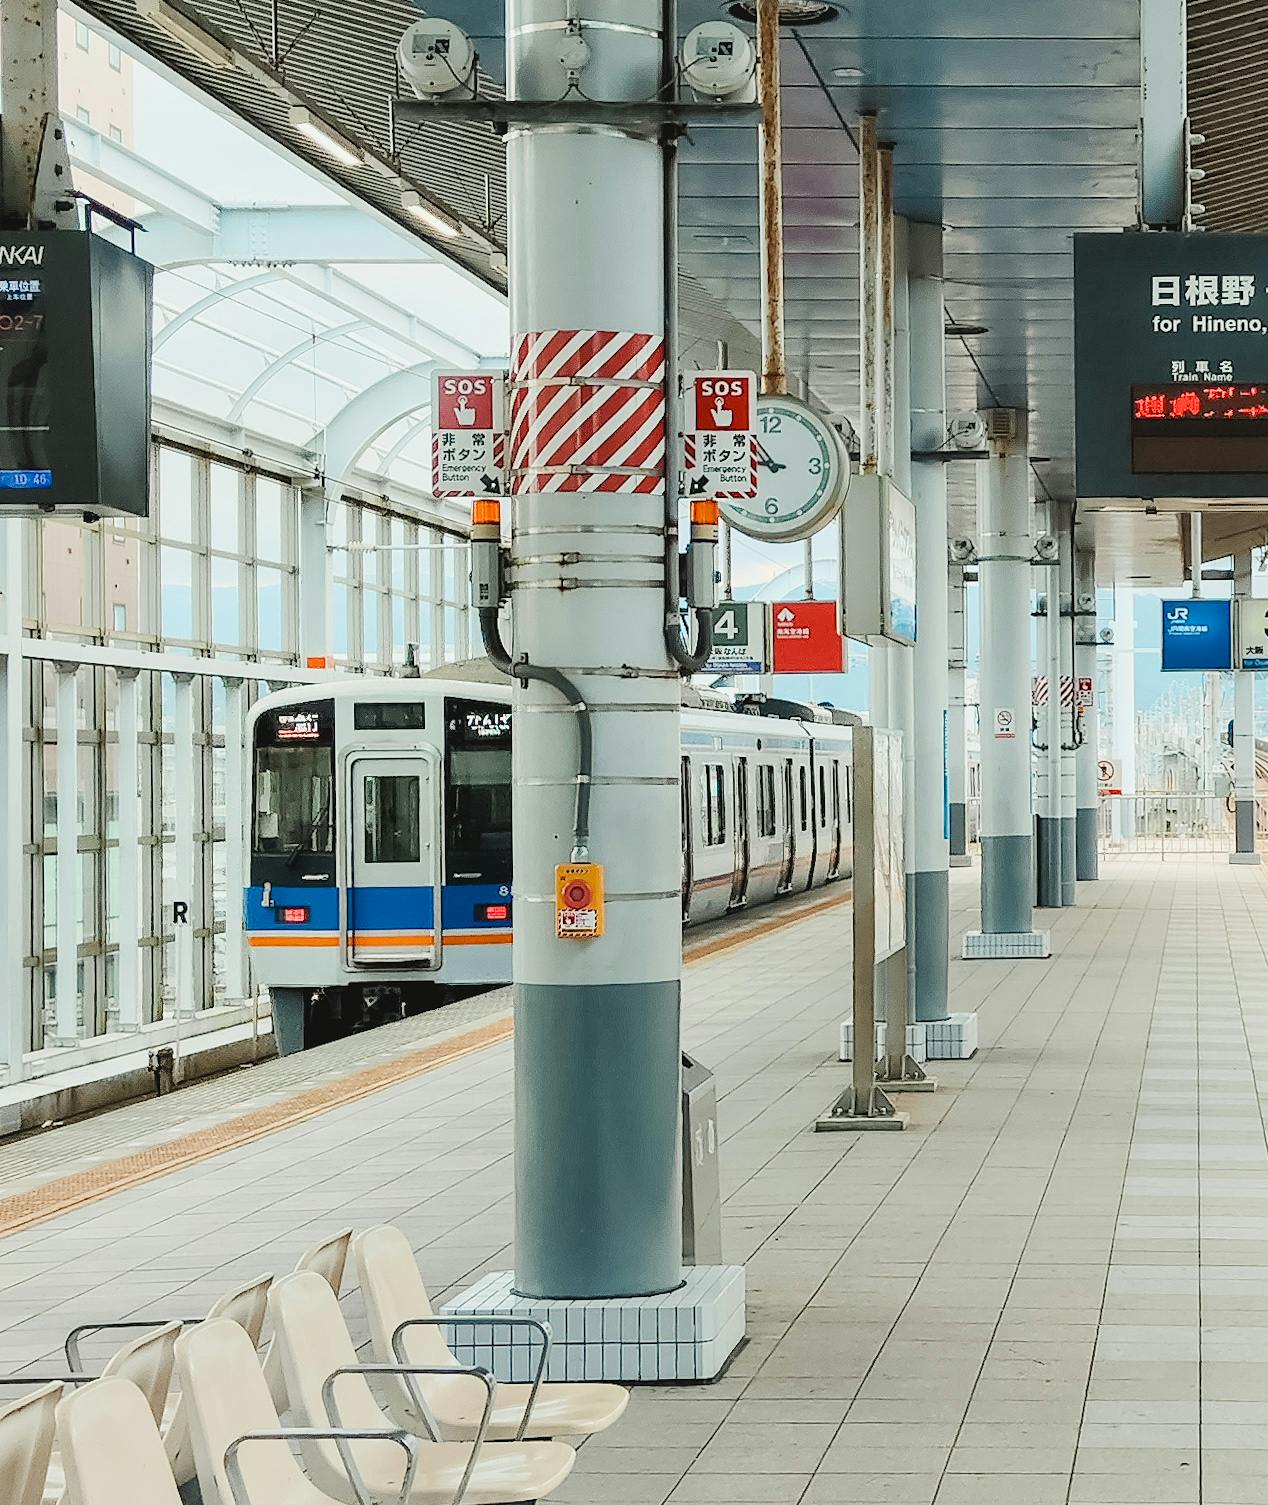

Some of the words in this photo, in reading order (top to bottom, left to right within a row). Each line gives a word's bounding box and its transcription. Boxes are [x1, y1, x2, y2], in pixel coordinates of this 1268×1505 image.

[1152, 315, 1182, 333] for
[1192, 315, 1268, 335] Hineno,
[1172, 372, 1199, 382] Train
[1203, 372, 1234, 382] Name
[444, 379, 486, 395] SOS
[701, 380, 743, 396] SOS
[760, 416, 782, 434] 12
[442, 433, 486, 446] 非常
[703, 434, 746, 447] 非常
[443, 448, 486, 462] ボタン
[703, 449, 746, 463] ボタン
[442, 463, 487, 473] Emergency
[703, 464, 747, 474] Emergency
[808, 457, 822, 475] 3
[442, 473, 470, 482] Button
[720, 474, 747, 483] Button
[764, 497, 779, 515] 6
[1167, 607, 1189, 620] JR
[714, 610, 739, 640] 4
[173, 901, 188, 924] R
